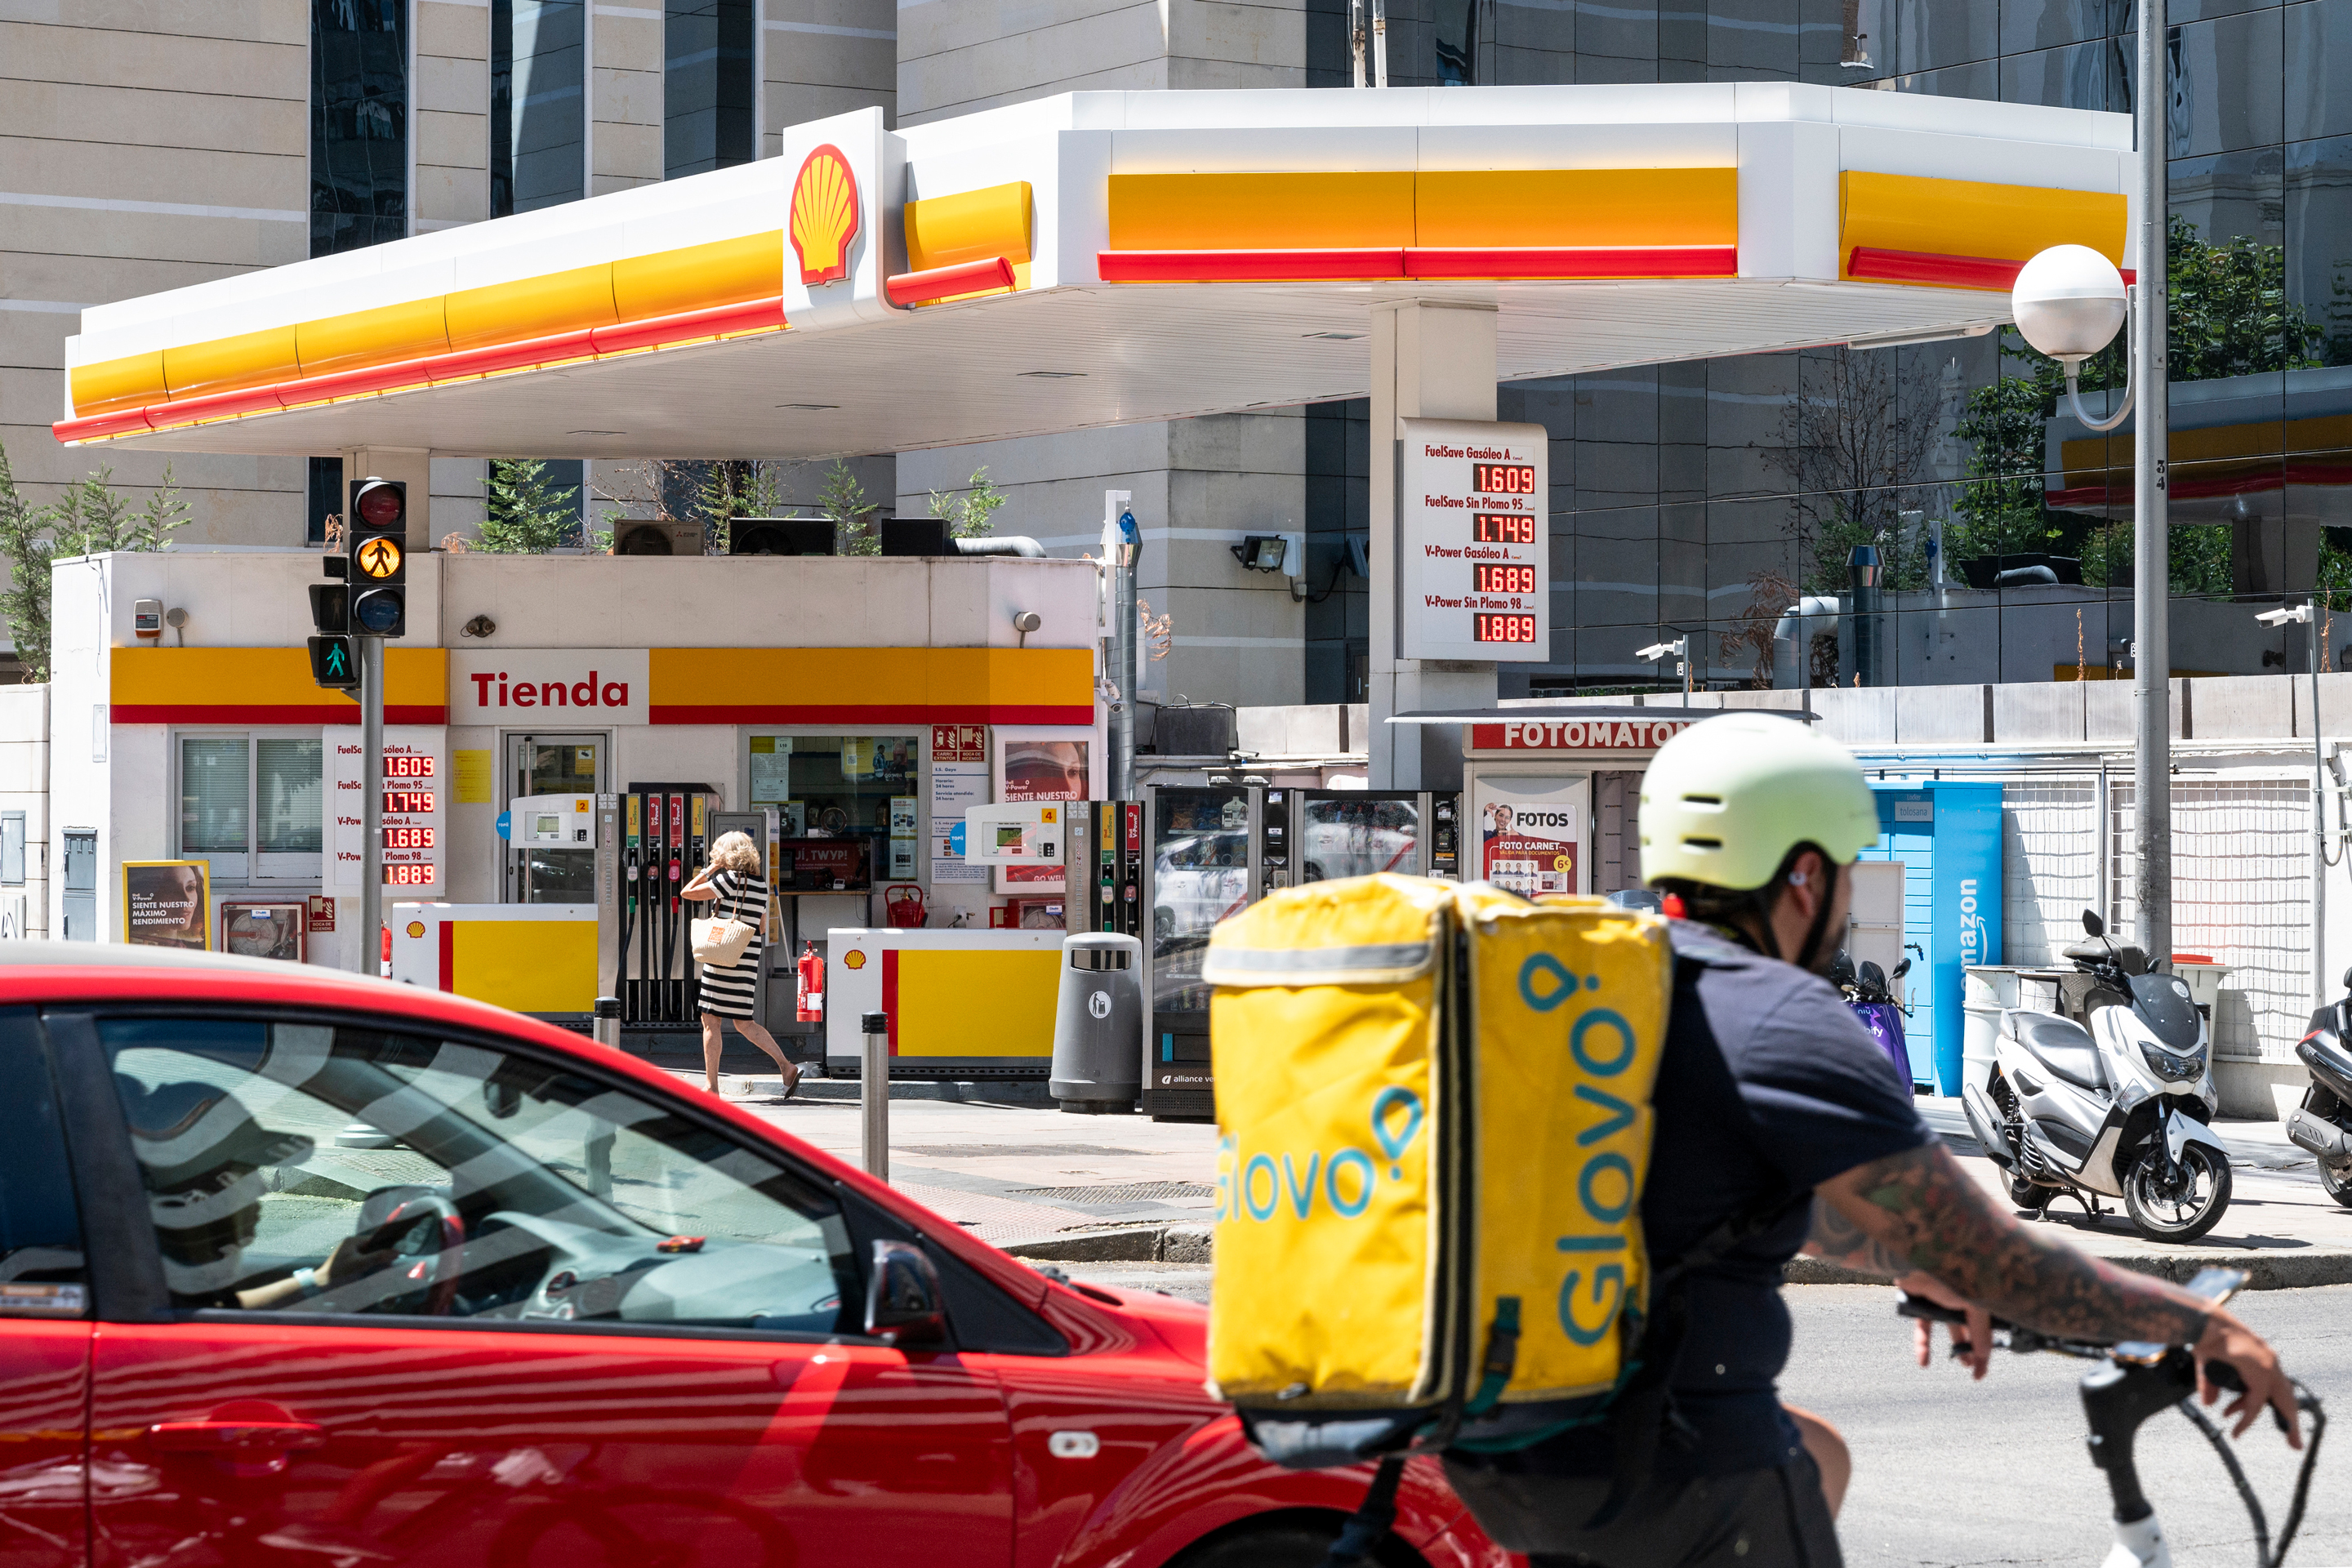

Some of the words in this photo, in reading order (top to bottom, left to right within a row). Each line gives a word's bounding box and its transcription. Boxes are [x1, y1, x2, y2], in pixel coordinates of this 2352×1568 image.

[1425, 445, 1463, 458] FuelSave
[1466, 446, 1502, 460] Gasóleo
[1503, 448, 1511, 460] A
[1479, 466, 1533, 493] 1.609
[1425, 495, 1463, 508] FuelSave
[1466, 497, 1479, 509] Sin
[1482, 497, 1509, 510] Plomo
[1512, 498, 1523, 510] 95
[1479, 516, 1533, 543] 1.749
[1424, 545, 1462, 559] V-Power
[1464, 546, 1501, 559] Gasóleo
[1502, 547, 1509, 559] A
[1479, 567, 1533, 593] 1.689
[1424, 595, 1462, 608] V-Power
[1464, 596, 1478, 608] Sin
[1480, 596, 1508, 610] Plomo
[1510, 597, 1521, 609] 98
[1479, 615, 1533, 641] 1.889
[471, 670, 628, 707] Tienda
[1504, 723, 1696, 747] FOTOMATO
[337, 745, 362, 755] FuelSa
[383, 744, 404, 754] sóleo
[406, 745, 412, 754] A
[387, 757, 434, 776] 1.609
[337, 781, 361, 790] FuelSa
[387, 781, 411, 790] Plomo
[413, 781, 423, 790] 95
[387, 792, 434, 812] 1.749
[1005, 792, 1034, 802] SIENTE
[1036, 791, 1077, 800] NUESTRO
[1045, 812, 1052, 820] 4
[1900, 807, 1927, 816] tolosana
[337, 817, 361, 826] V-Pow
[382, 816, 403, 826] sóleo
[404, 817, 411, 825] A
[1517, 813, 1569, 826] FOTOS
[387, 828, 434, 847] 1.689
[1499, 841, 1522, 849] FOTO
[1524, 841, 1560, 850] CARNET
[337, 853, 361, 862] V-Pow
[385, 852, 409, 861] Plomo
[412, 852, 421, 860] 98
[1557, 859, 1569, 869] 6€
[387, 866, 434, 884] 1.889
[132, 909, 167, 917] MÁXIMO
[132, 917, 185, 925] RENDIMIENTO
[1864, 1026, 1883, 1037] bify
[1556, 1008, 1636, 1348] Glovo
